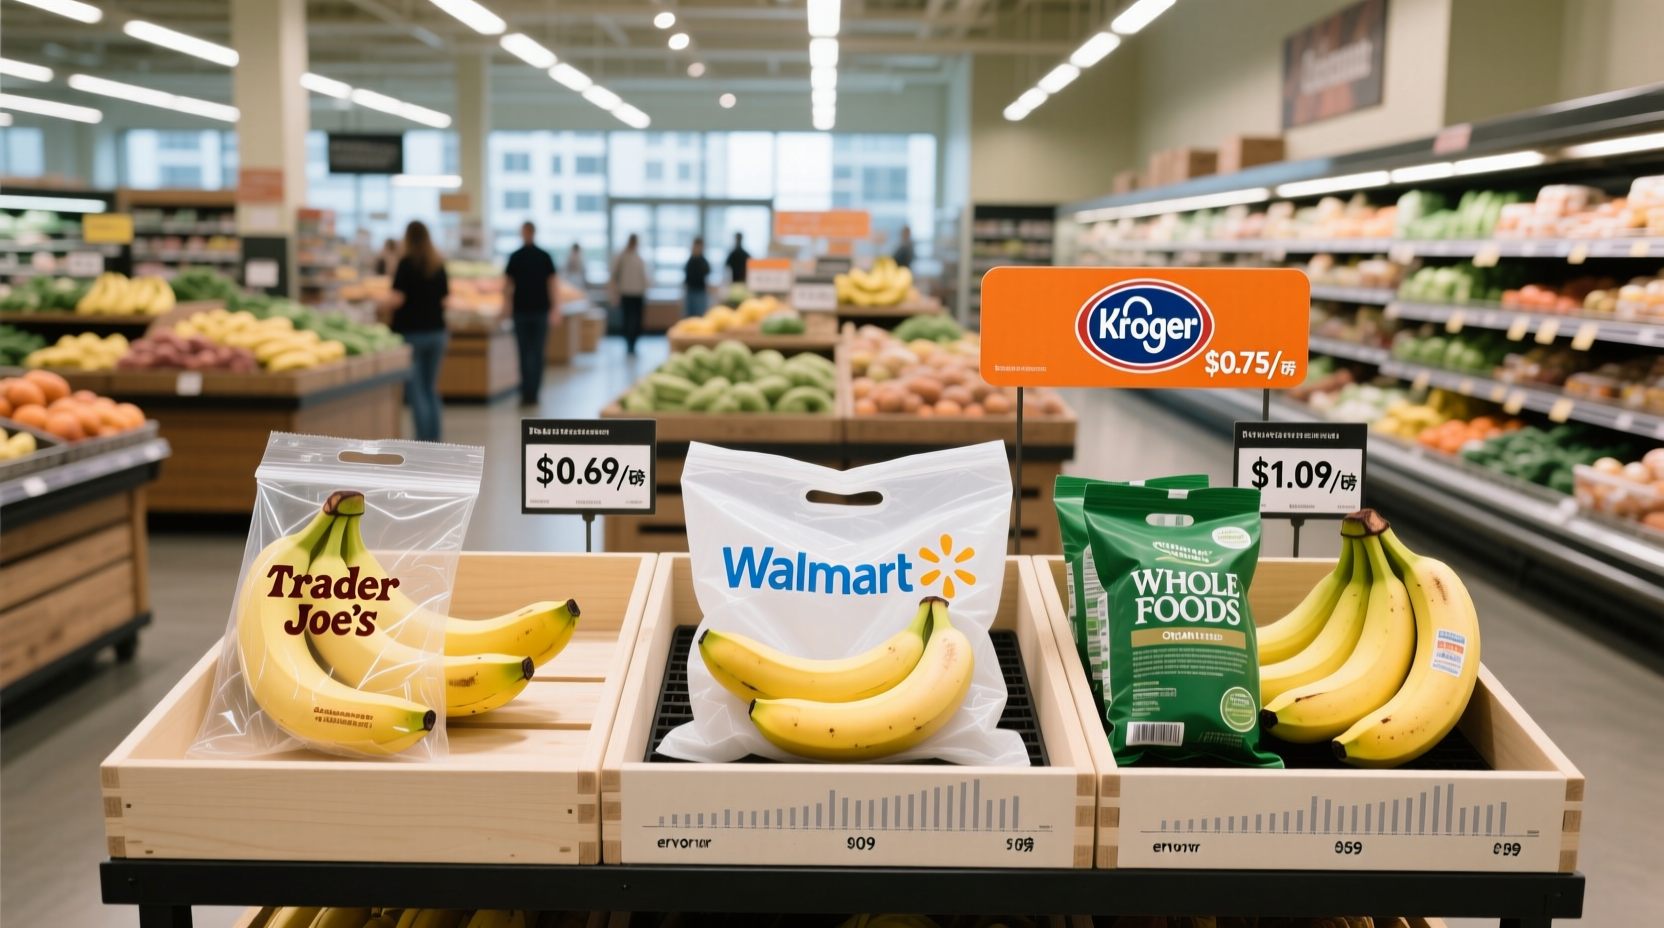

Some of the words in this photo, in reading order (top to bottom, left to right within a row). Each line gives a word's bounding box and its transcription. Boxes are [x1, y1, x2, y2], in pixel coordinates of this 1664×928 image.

[1099, 296, 1198, 354] Kroger
[266, 564, 400, 601] Trader
[722, 546, 914, 595] Walmart
[1130, 568, 1240, 598] WHOLE
[284, 603, 378, 637] Joe's
[1135, 595, 1241, 626] FOODS
